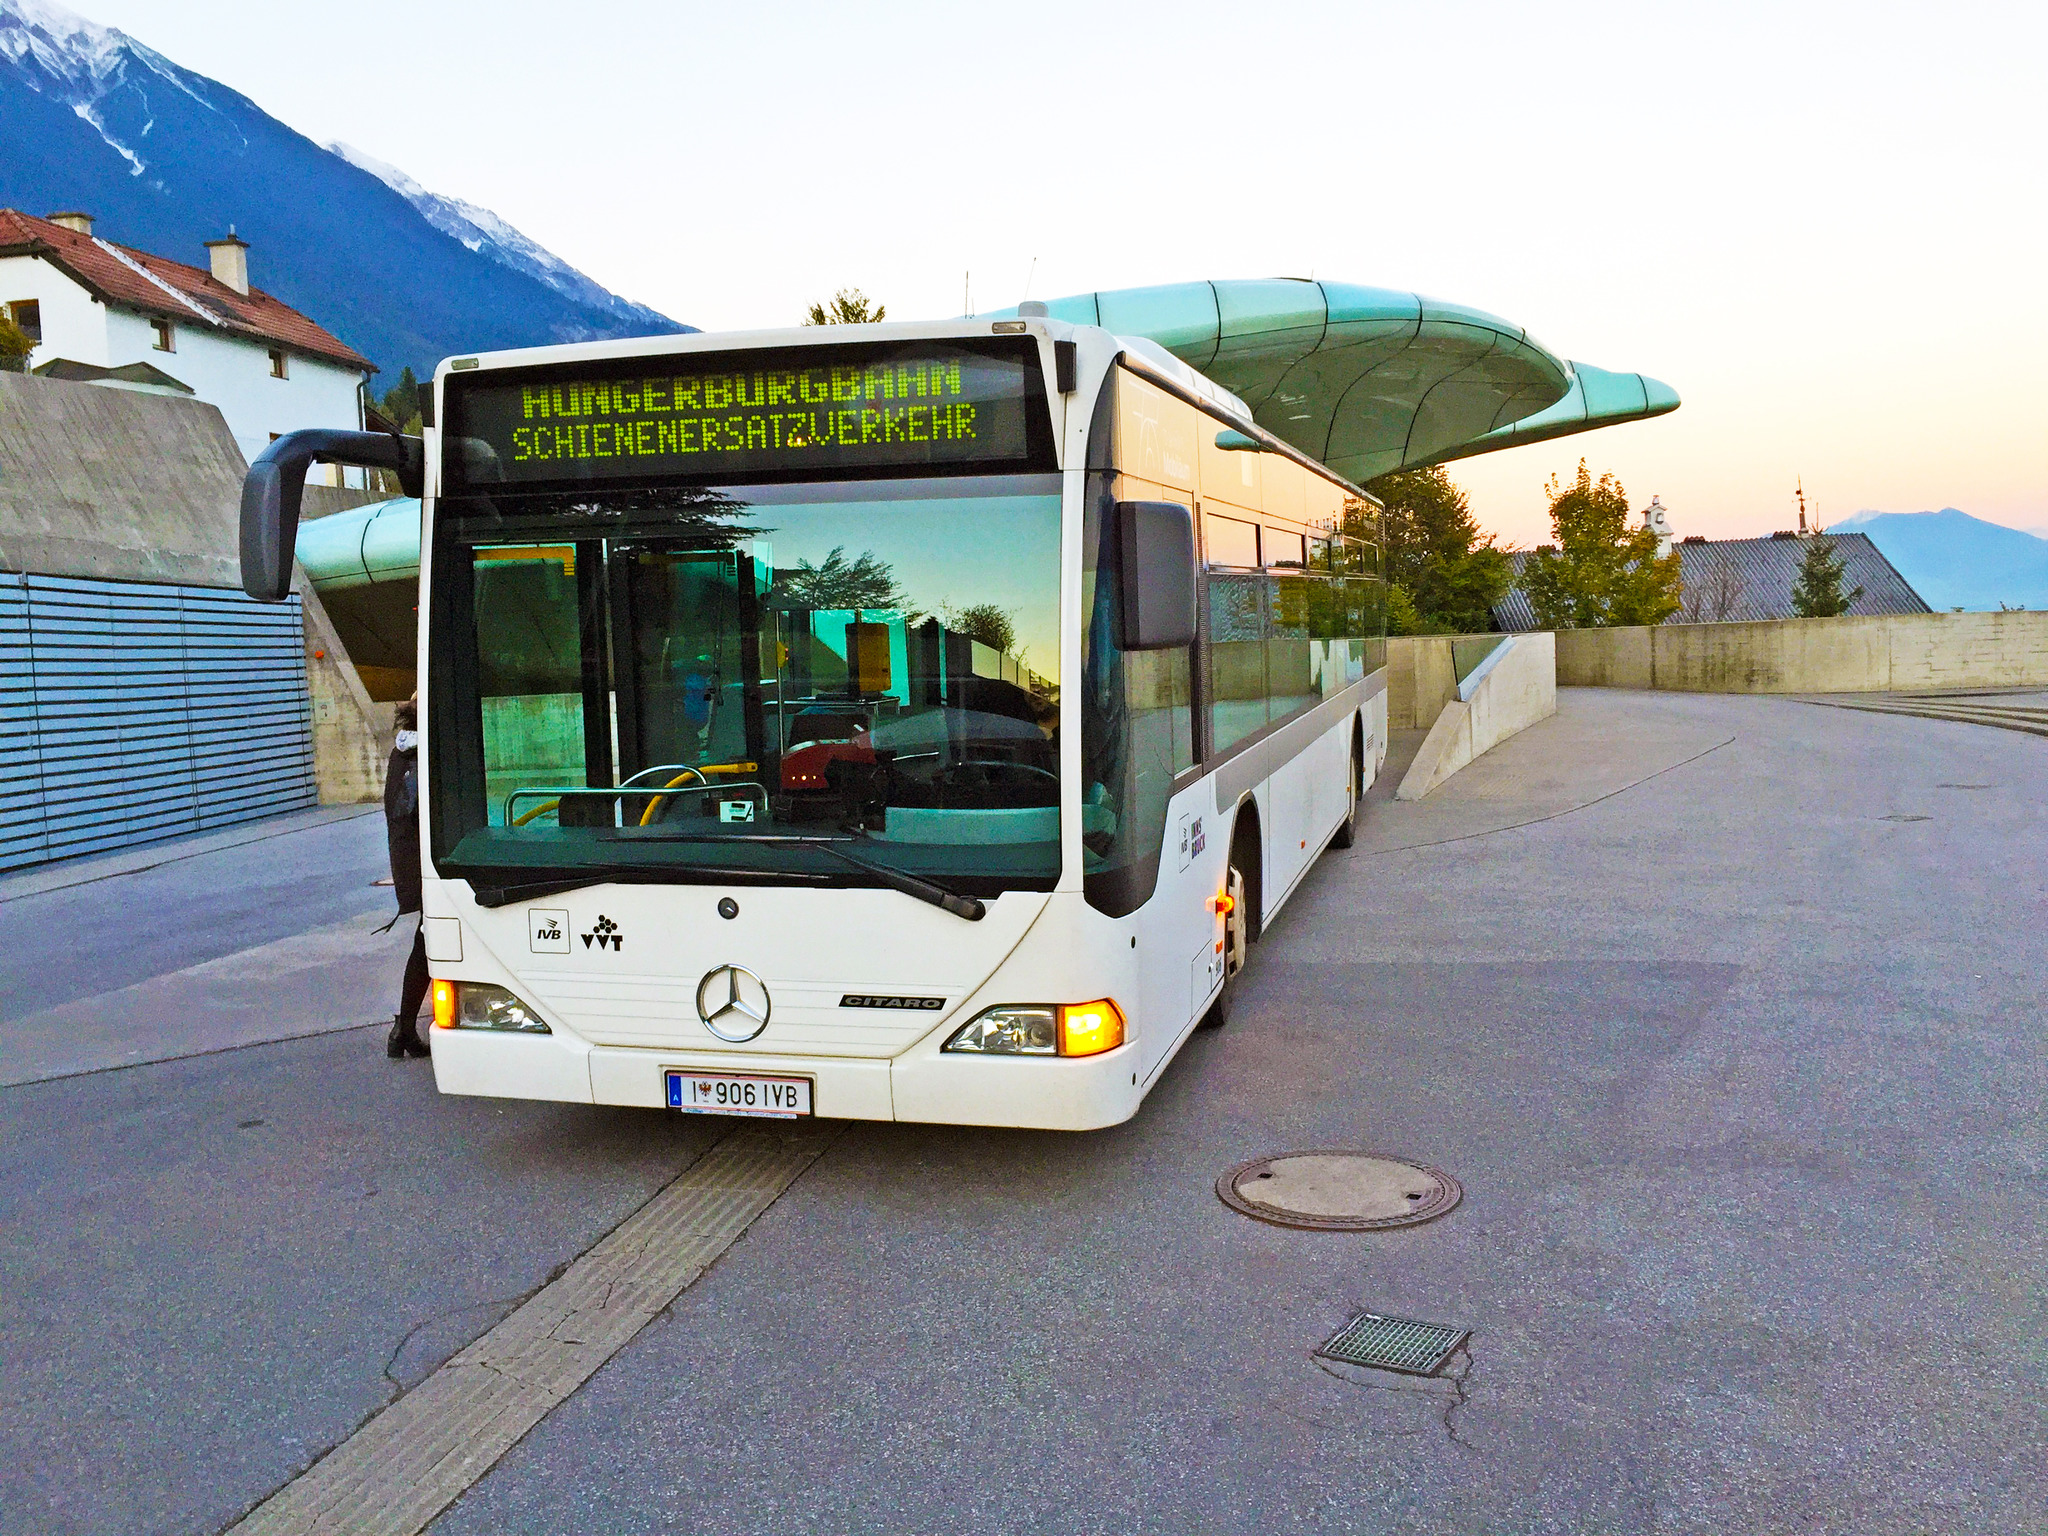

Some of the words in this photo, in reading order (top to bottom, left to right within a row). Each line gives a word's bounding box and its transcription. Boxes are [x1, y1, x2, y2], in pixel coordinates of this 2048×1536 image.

[521, 359, 961, 419] HUNGERBURGBAHN
[513, 403, 977, 461] SCHIENENERSATZVERKEHR
[537, 929, 562, 940] IVB
[580, 934, 624, 952] VVT
[845, 996, 941, 1008] CITARO
[716, 1081, 756, 1106] 906
[764, 1084, 797, 1107] IVB
